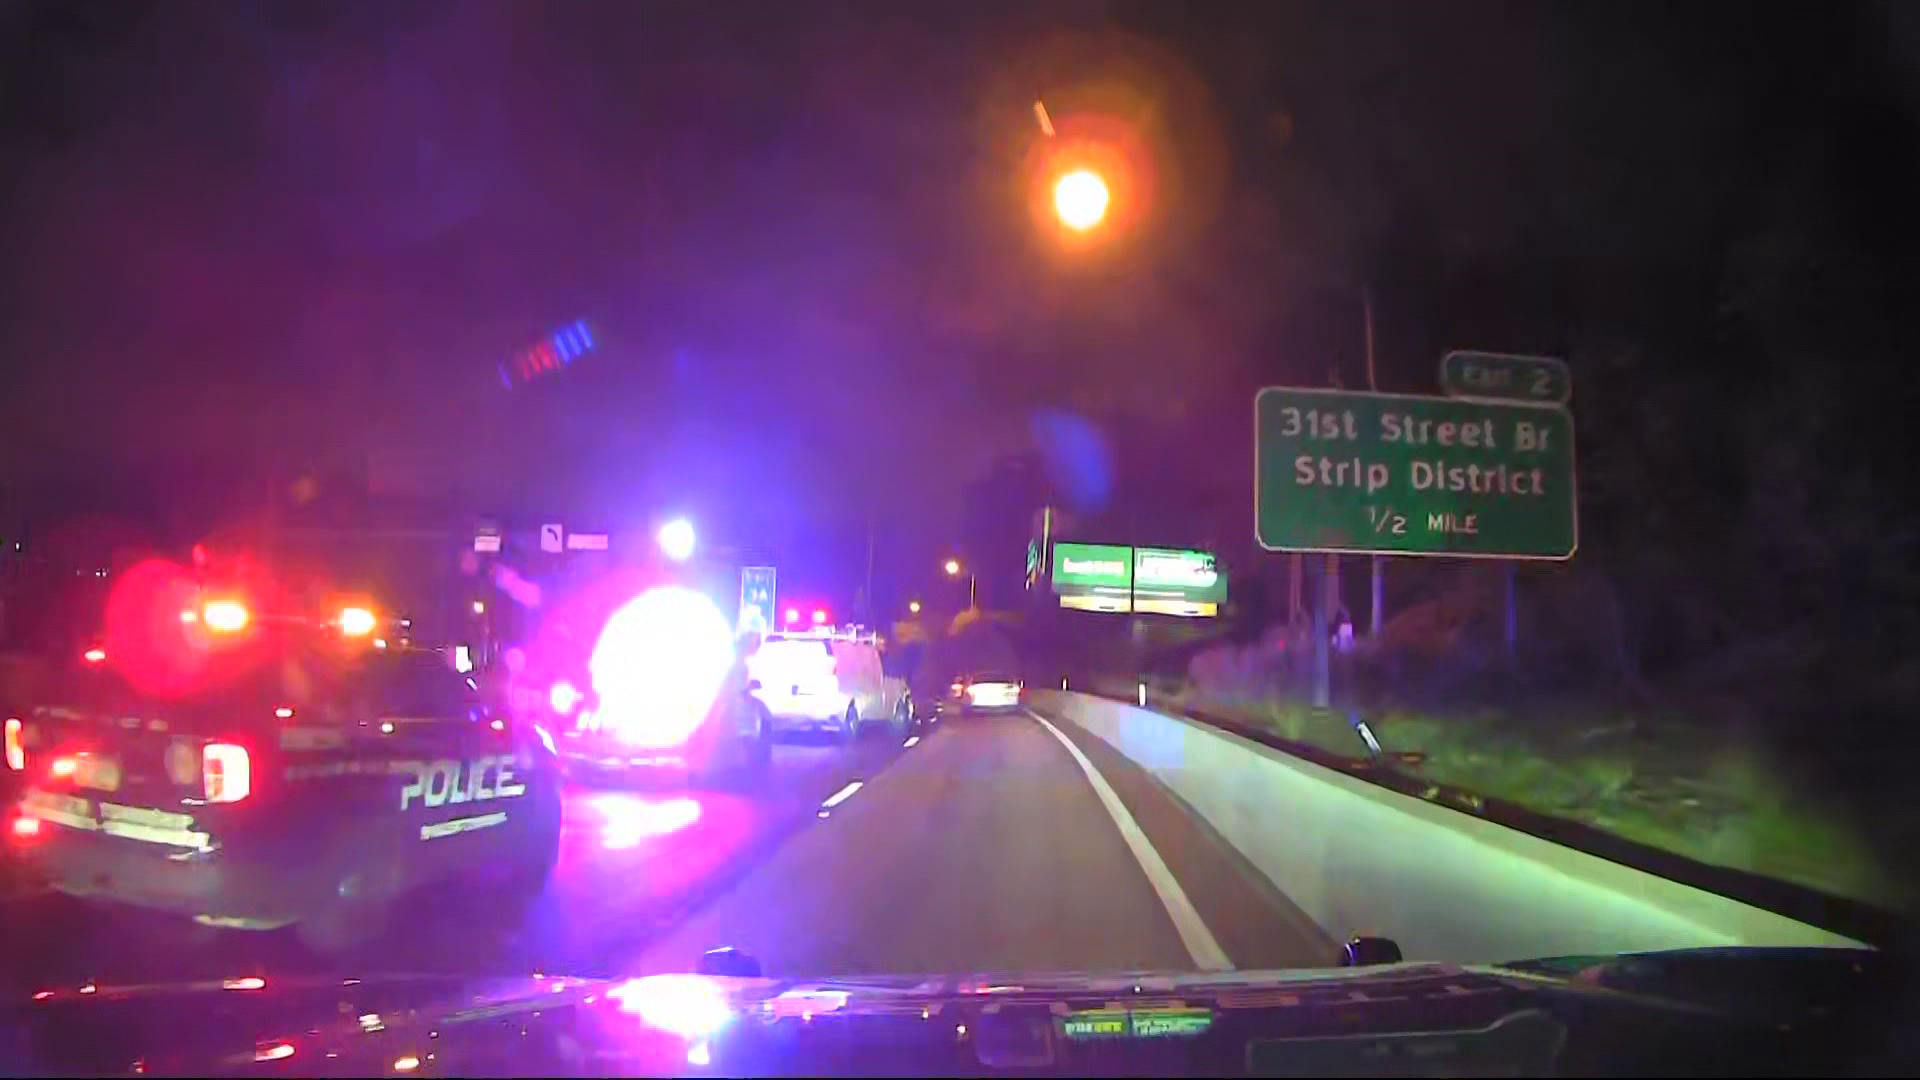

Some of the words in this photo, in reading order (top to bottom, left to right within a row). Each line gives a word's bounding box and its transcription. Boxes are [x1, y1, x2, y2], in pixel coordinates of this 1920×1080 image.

[1531, 367, 1552, 394] 2
[1280, 406, 1358, 440] 31st
[1382, 413, 1496, 447] Street
[1515, 421, 1551, 451] Br
[1294, 456, 1389, 495] Strip
[1411, 460, 1544, 495] District
[1428, 512, 1477, 534] MILE
[396, 756, 525, 811] POLICE
